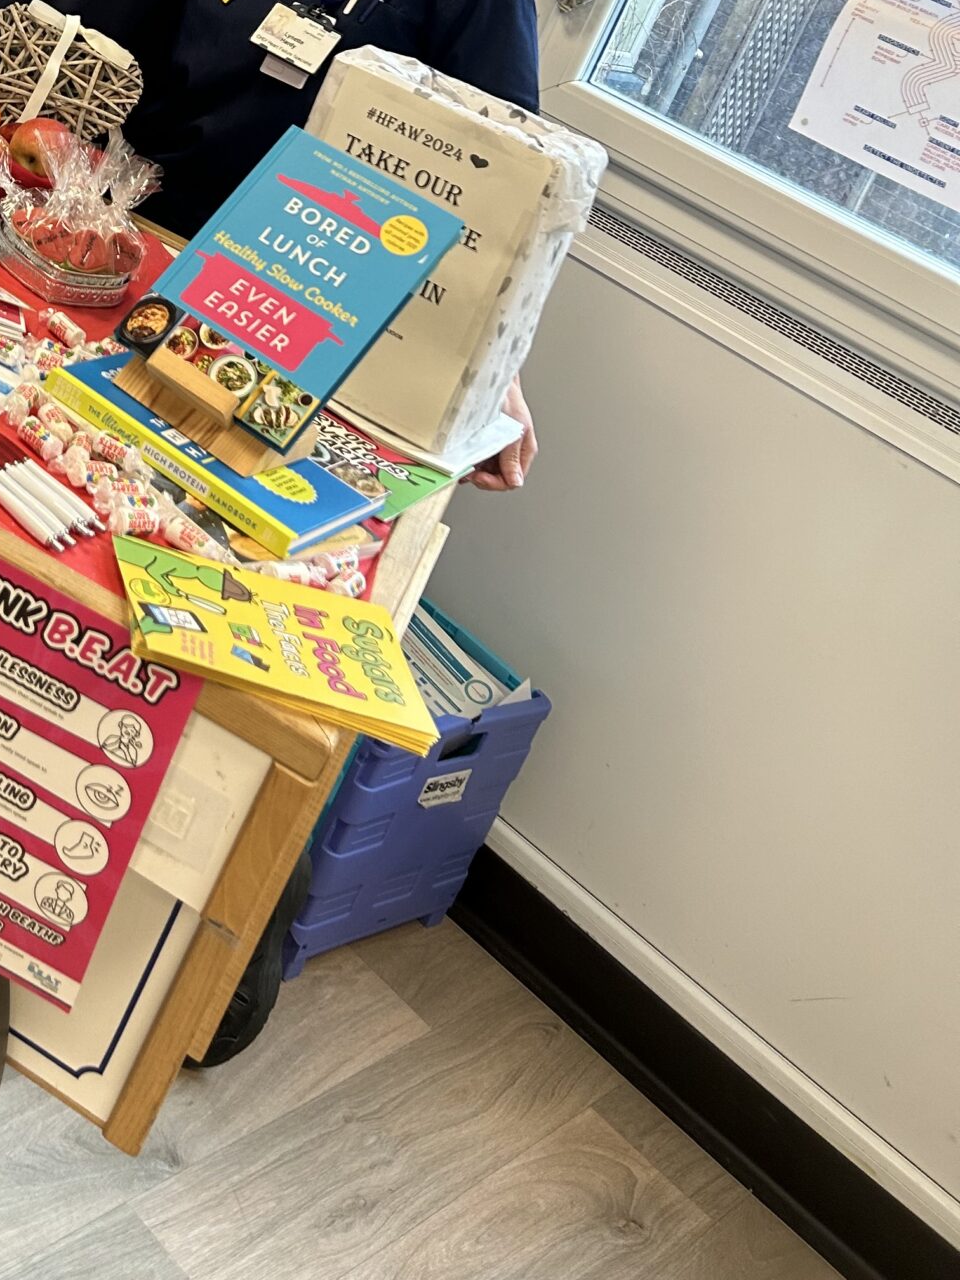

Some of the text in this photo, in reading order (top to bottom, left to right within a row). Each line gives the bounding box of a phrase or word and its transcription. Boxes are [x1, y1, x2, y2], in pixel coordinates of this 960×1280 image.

[363, 104, 466, 164] #HFAW2024
[339, 132, 467, 207] TAKE OUR
[256, 223, 349, 290] LUNCH
[282, 194, 375, 258] BORED
[304, 231, 329, 251] OF
[211, 227, 361, 329] Healthy Slow Cooker
[227, 274, 298, 329] EVEN
[201, 287, 293, 355] EASIER
[86, 404, 102, 419] THE
[98, 409, 143, 448] Ultimate
[141, 443, 169, 468] HIGH
[165, 460, 209, 496] PROTEIN
[207, 491, 259, 531] HANDBOOK
[342, 430, 375, 451] OF
[260, 600, 310, 678] The Facts
[293, 604, 368, 701] in Food
[342, 615, 406, 706] Sugars
[423, 776, 466, 793] Slingsby
[8, 909, 63, 947] BEATHF
